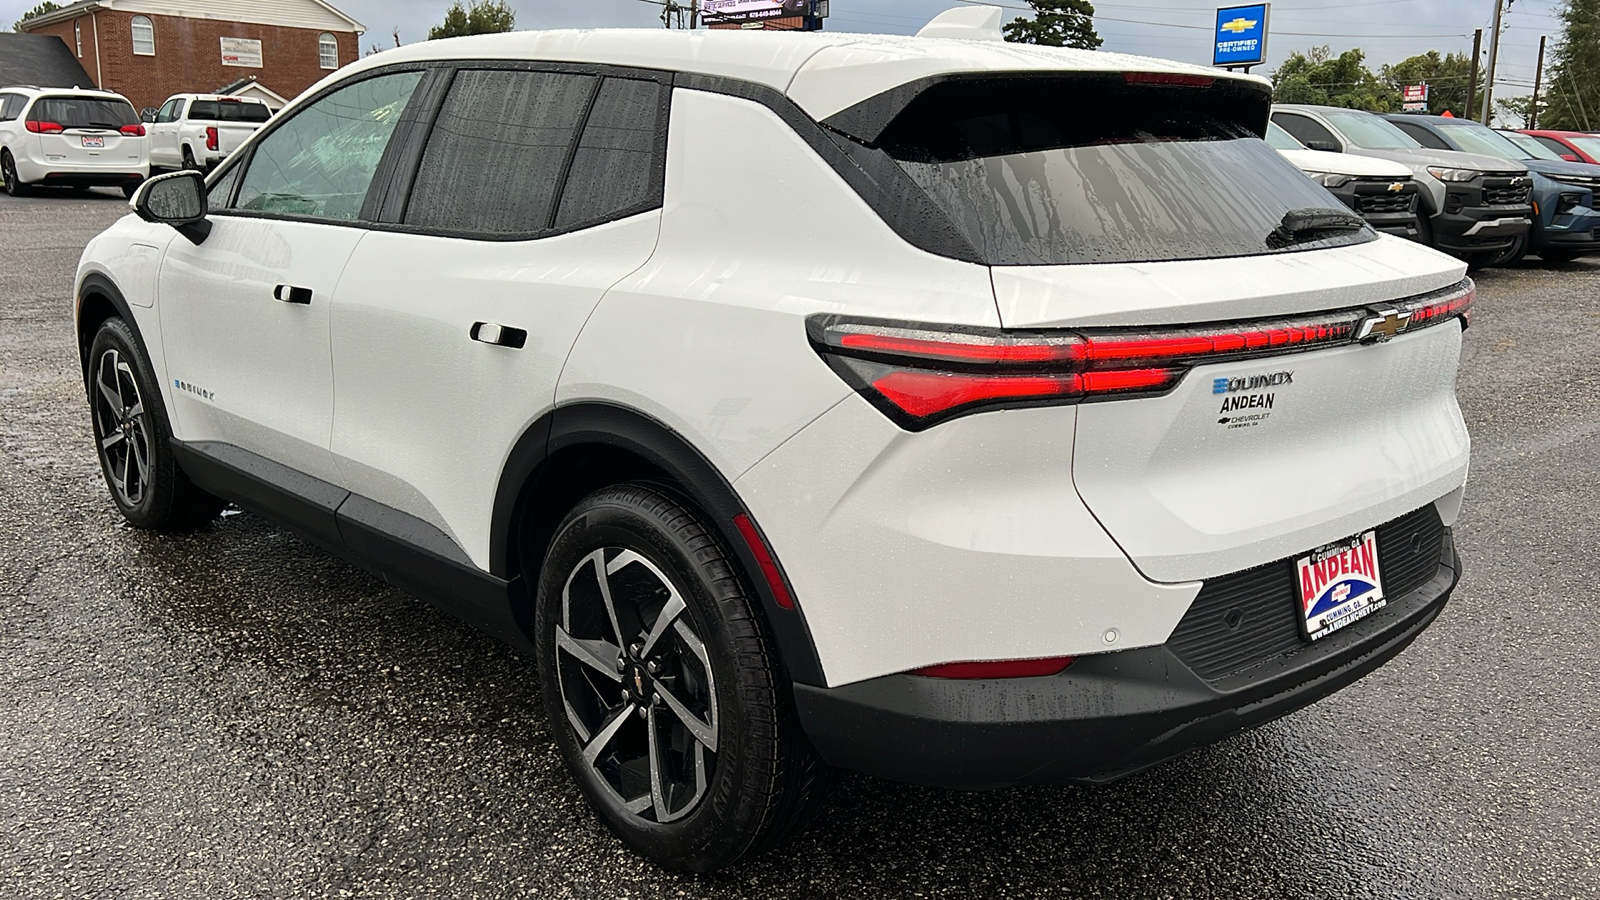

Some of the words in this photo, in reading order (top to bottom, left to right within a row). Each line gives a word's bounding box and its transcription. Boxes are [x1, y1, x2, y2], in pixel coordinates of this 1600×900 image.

[1217, 39, 1257, 48] CERTIFIED
[1219, 45, 1255, 53] PRE-OWNED
[174, 379, 215, 402] EQUINOX
[1212, 370, 1294, 394] EQUINOX
[1219, 393, 1275, 414] ANDEAN
[1231, 413, 1270, 423] CHEVROLET
[1302, 539, 1376, 613] ANDEAN
